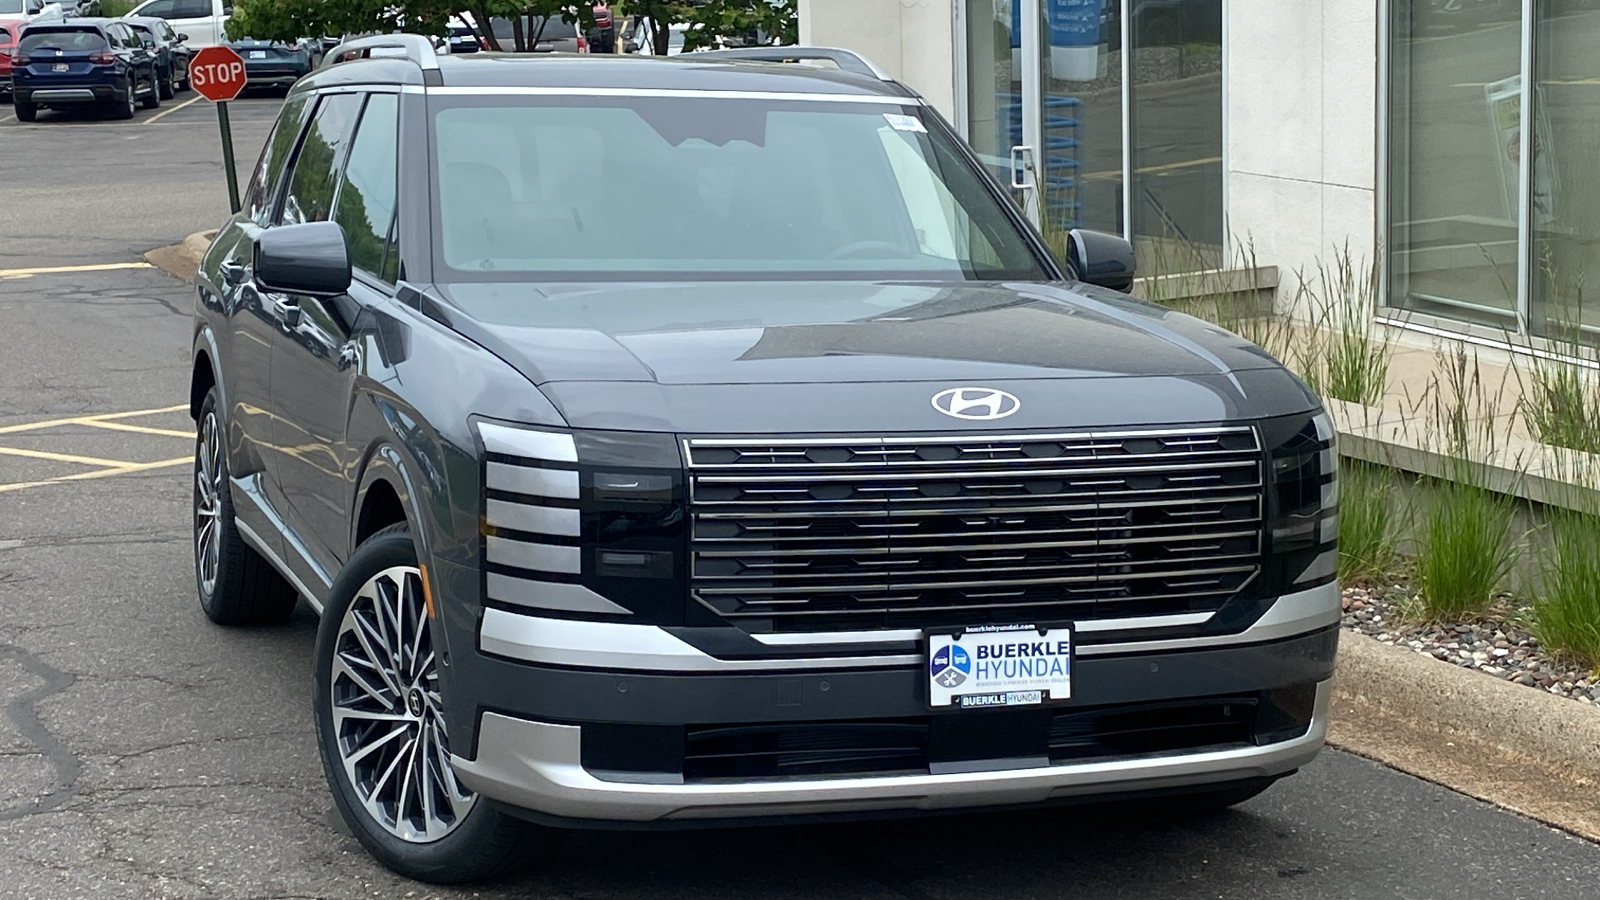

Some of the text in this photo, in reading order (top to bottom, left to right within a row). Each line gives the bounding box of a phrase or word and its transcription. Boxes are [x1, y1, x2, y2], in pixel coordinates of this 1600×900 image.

[193, 61, 242, 86] STOP
[976, 641, 1069, 660] BUERKLE
[976, 657, 1070, 680] HYUNDAI
[962, 692, 1040, 706] BUERKLE HYUNDAI
